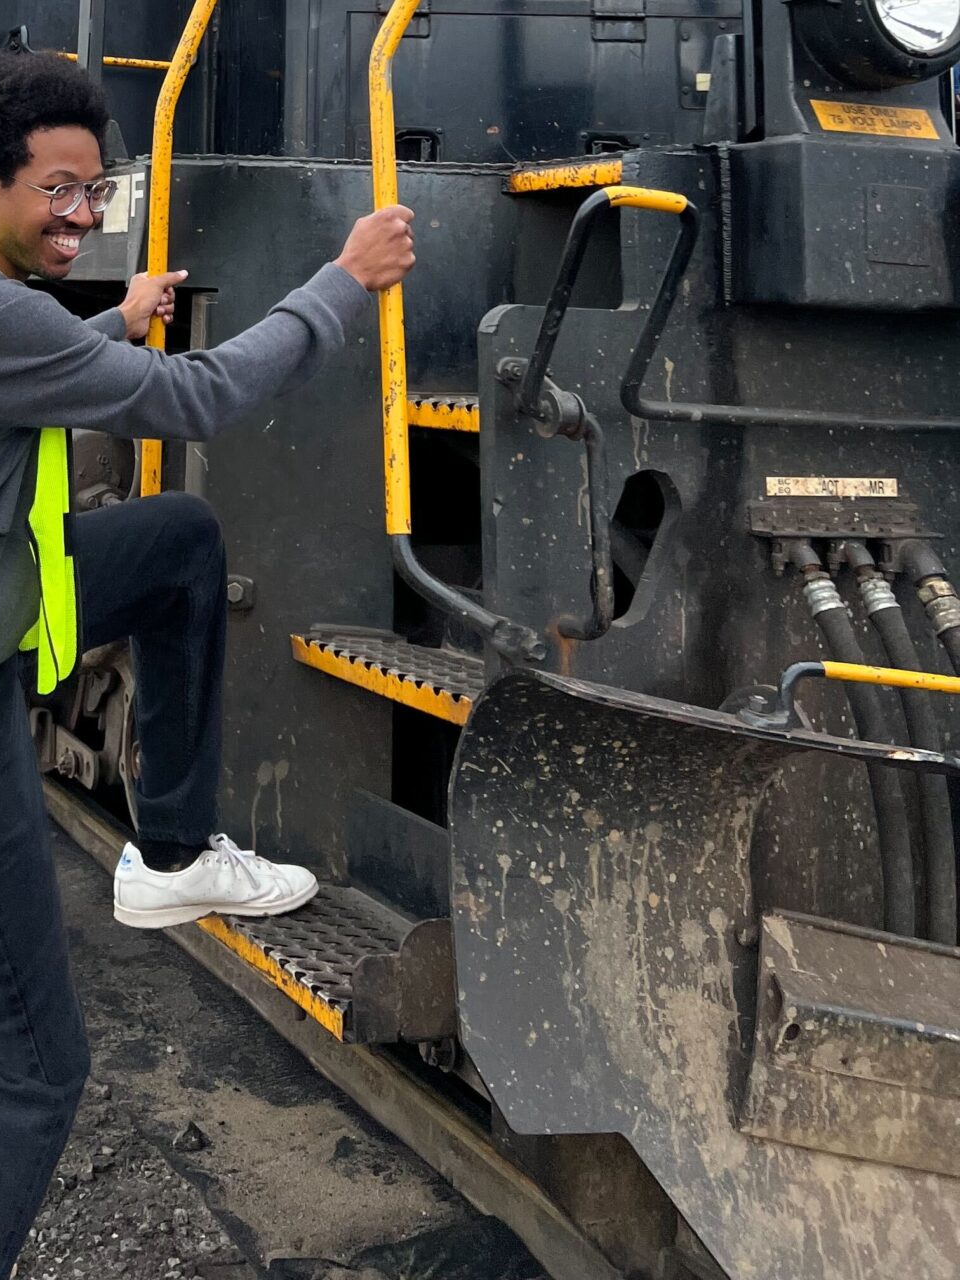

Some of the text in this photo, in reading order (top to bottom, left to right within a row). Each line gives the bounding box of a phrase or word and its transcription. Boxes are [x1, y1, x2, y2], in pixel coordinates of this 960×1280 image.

[841, 104, 898, 118] USE ONLY
[848, 115, 876, 127] VOLT
[881, 118, 922, 131] LAMPS
[130, 172, 146, 218] F
[821, 479, 840, 495] ACT
[868, 480, 885, 495] MR
